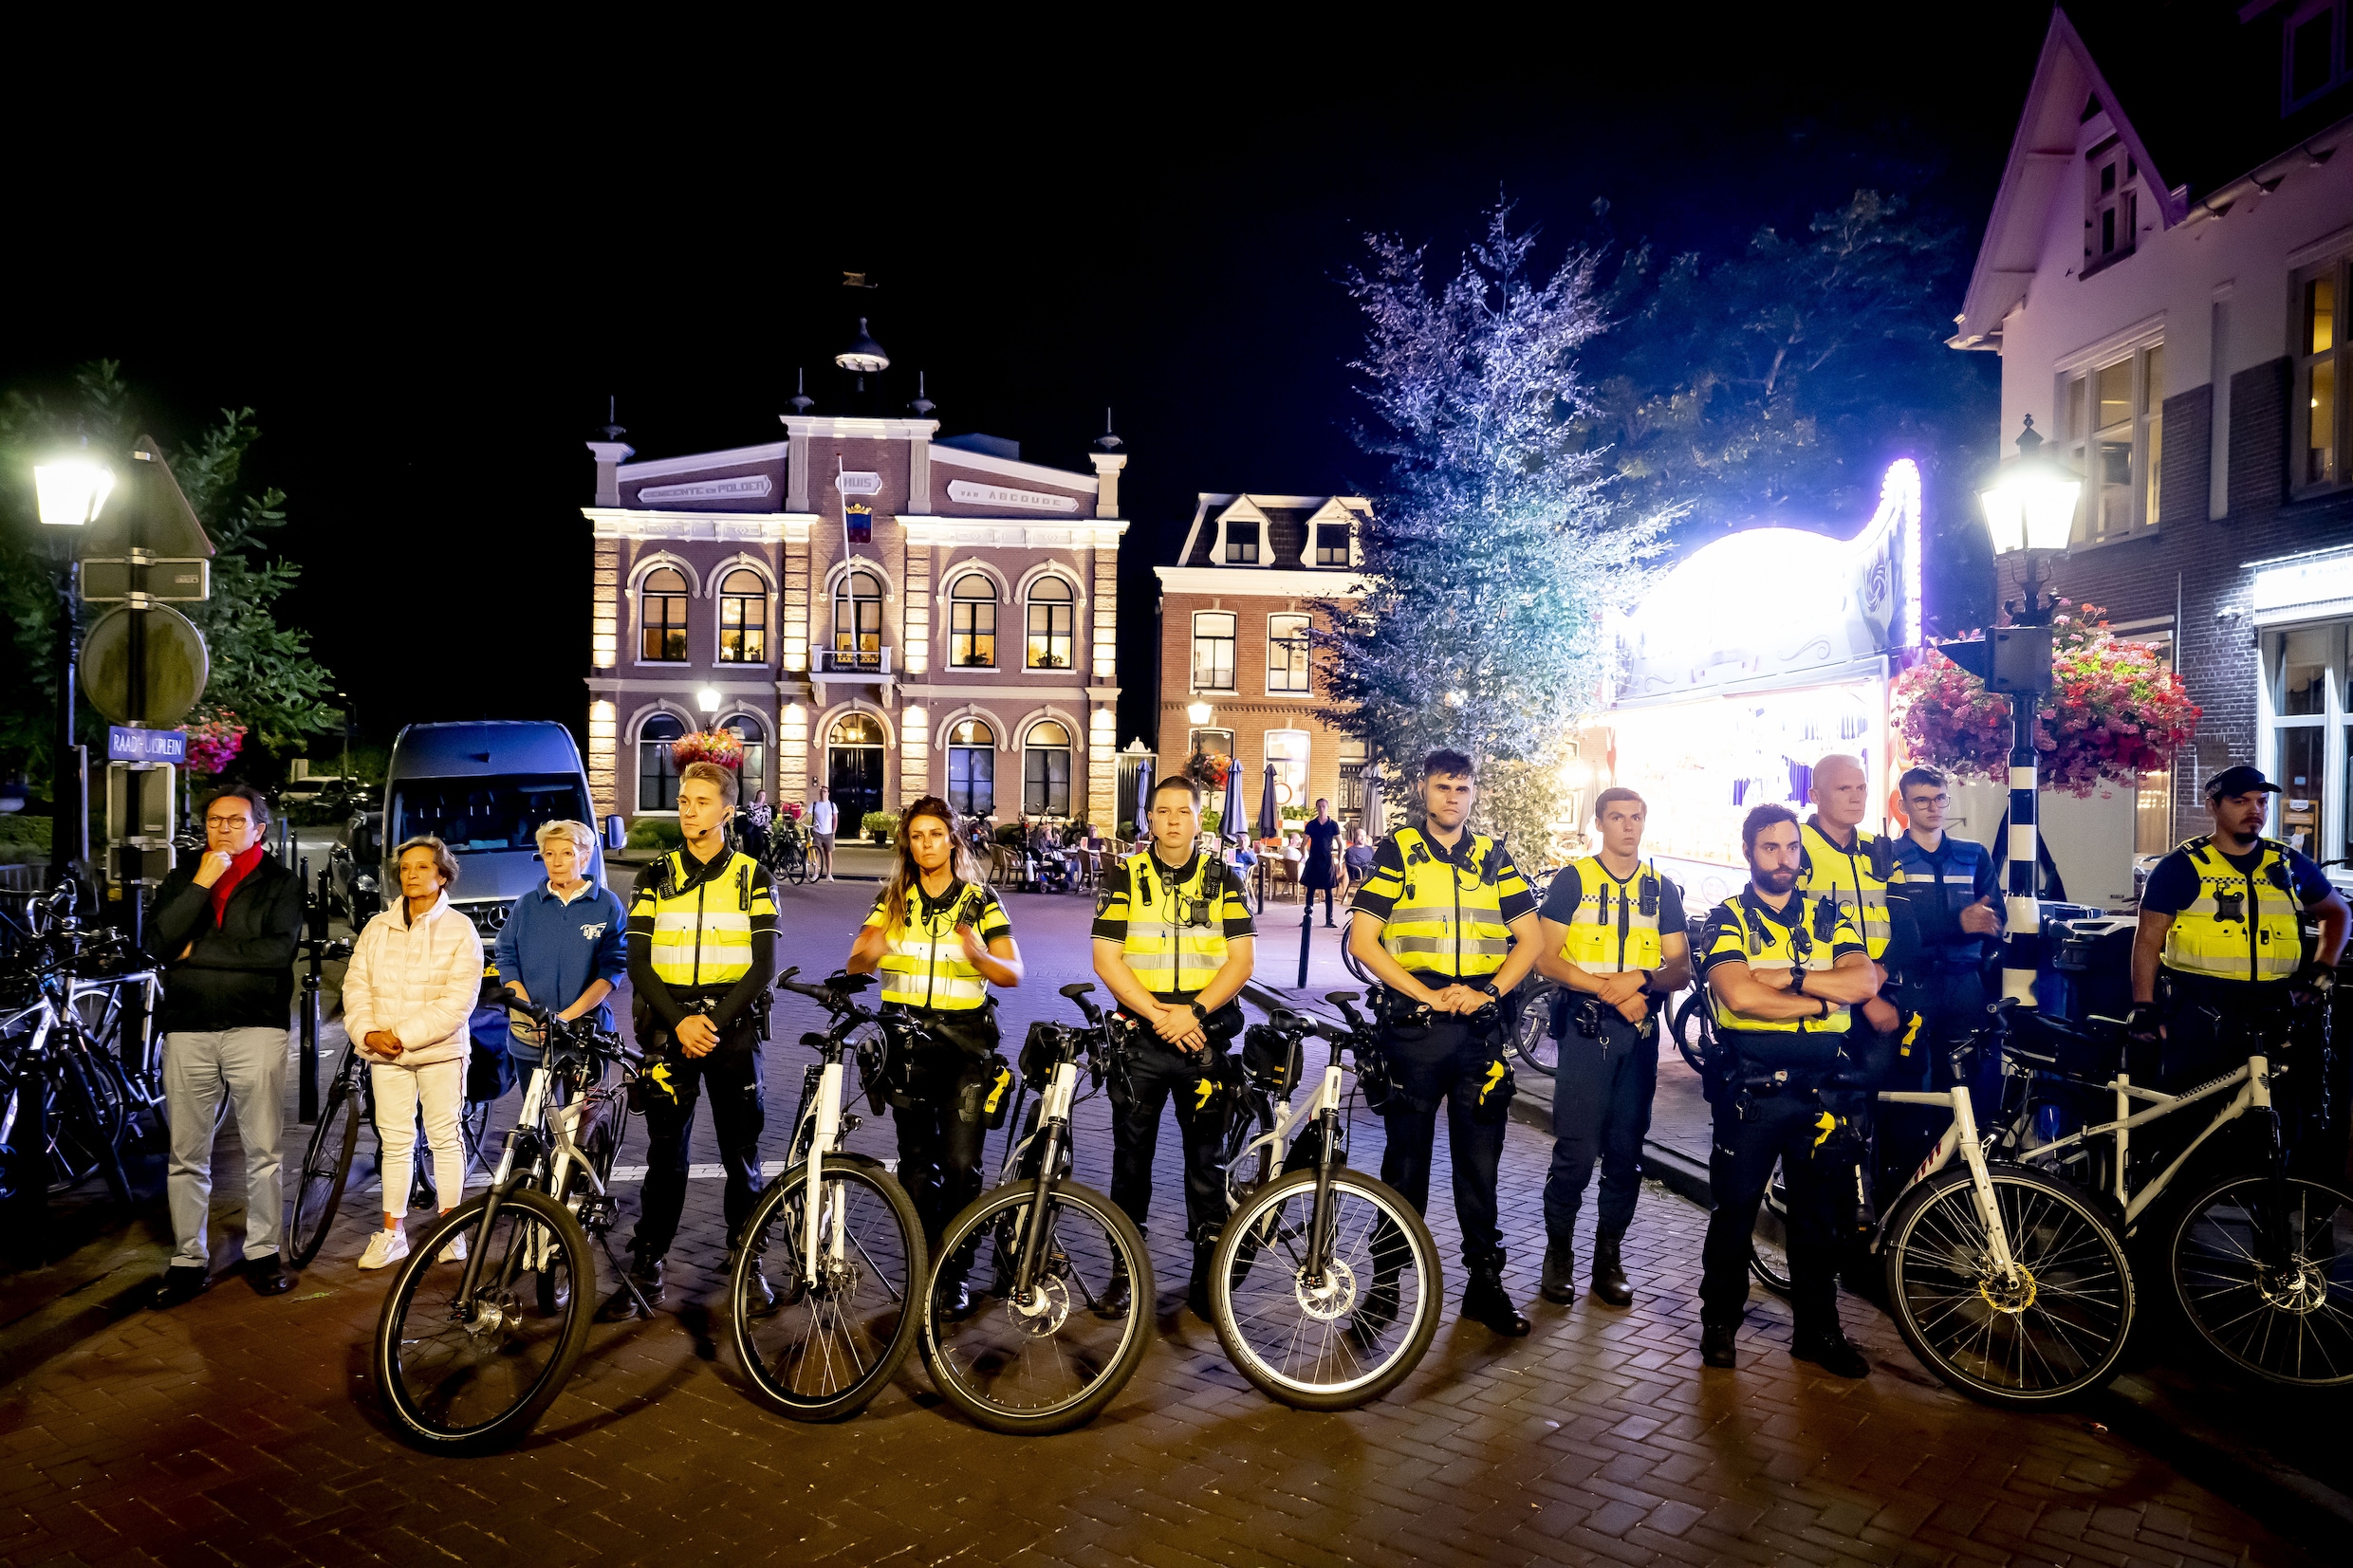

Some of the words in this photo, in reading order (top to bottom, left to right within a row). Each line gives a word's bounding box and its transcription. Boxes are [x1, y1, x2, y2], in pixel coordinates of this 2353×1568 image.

[717, 481, 765, 493] POLDER
[843, 477, 872, 488] HUIS
[989, 490, 1061, 507] ABCOUDE
